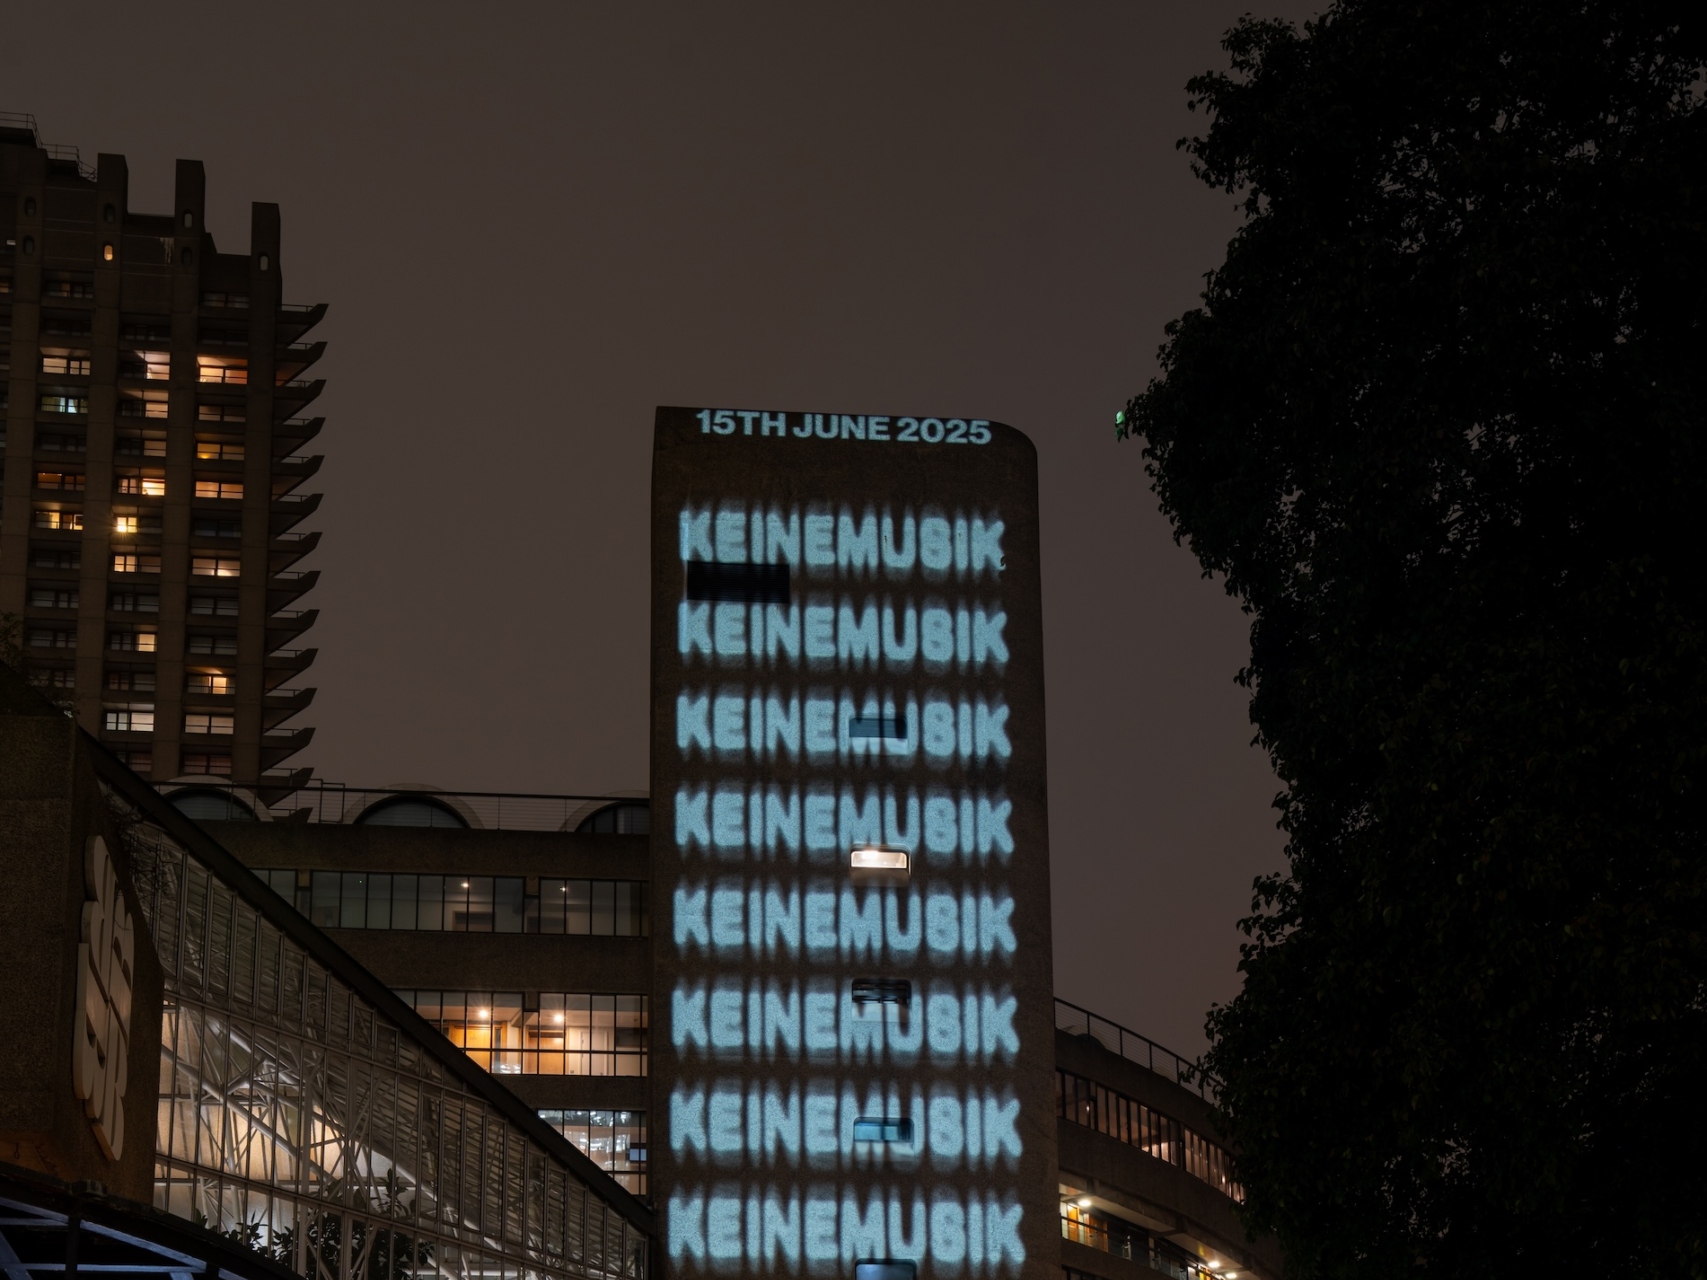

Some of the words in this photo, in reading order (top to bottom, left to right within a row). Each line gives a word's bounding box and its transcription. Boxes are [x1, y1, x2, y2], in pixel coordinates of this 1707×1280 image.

[697, 409, 786, 435] 15TH
[793, 413, 890, 440] JUNE
[897, 417, 992, 445] 2025
[679, 505, 1006, 573] KEINEMUSIK
[677, 597, 1010, 667] KEINEMUSIK
[673, 786, 1015, 859] KEINEMUSIK
[672, 883, 1017, 958] KEINEMUSIK
[666, 1191, 1026, 1268] KEINEMUSIK
